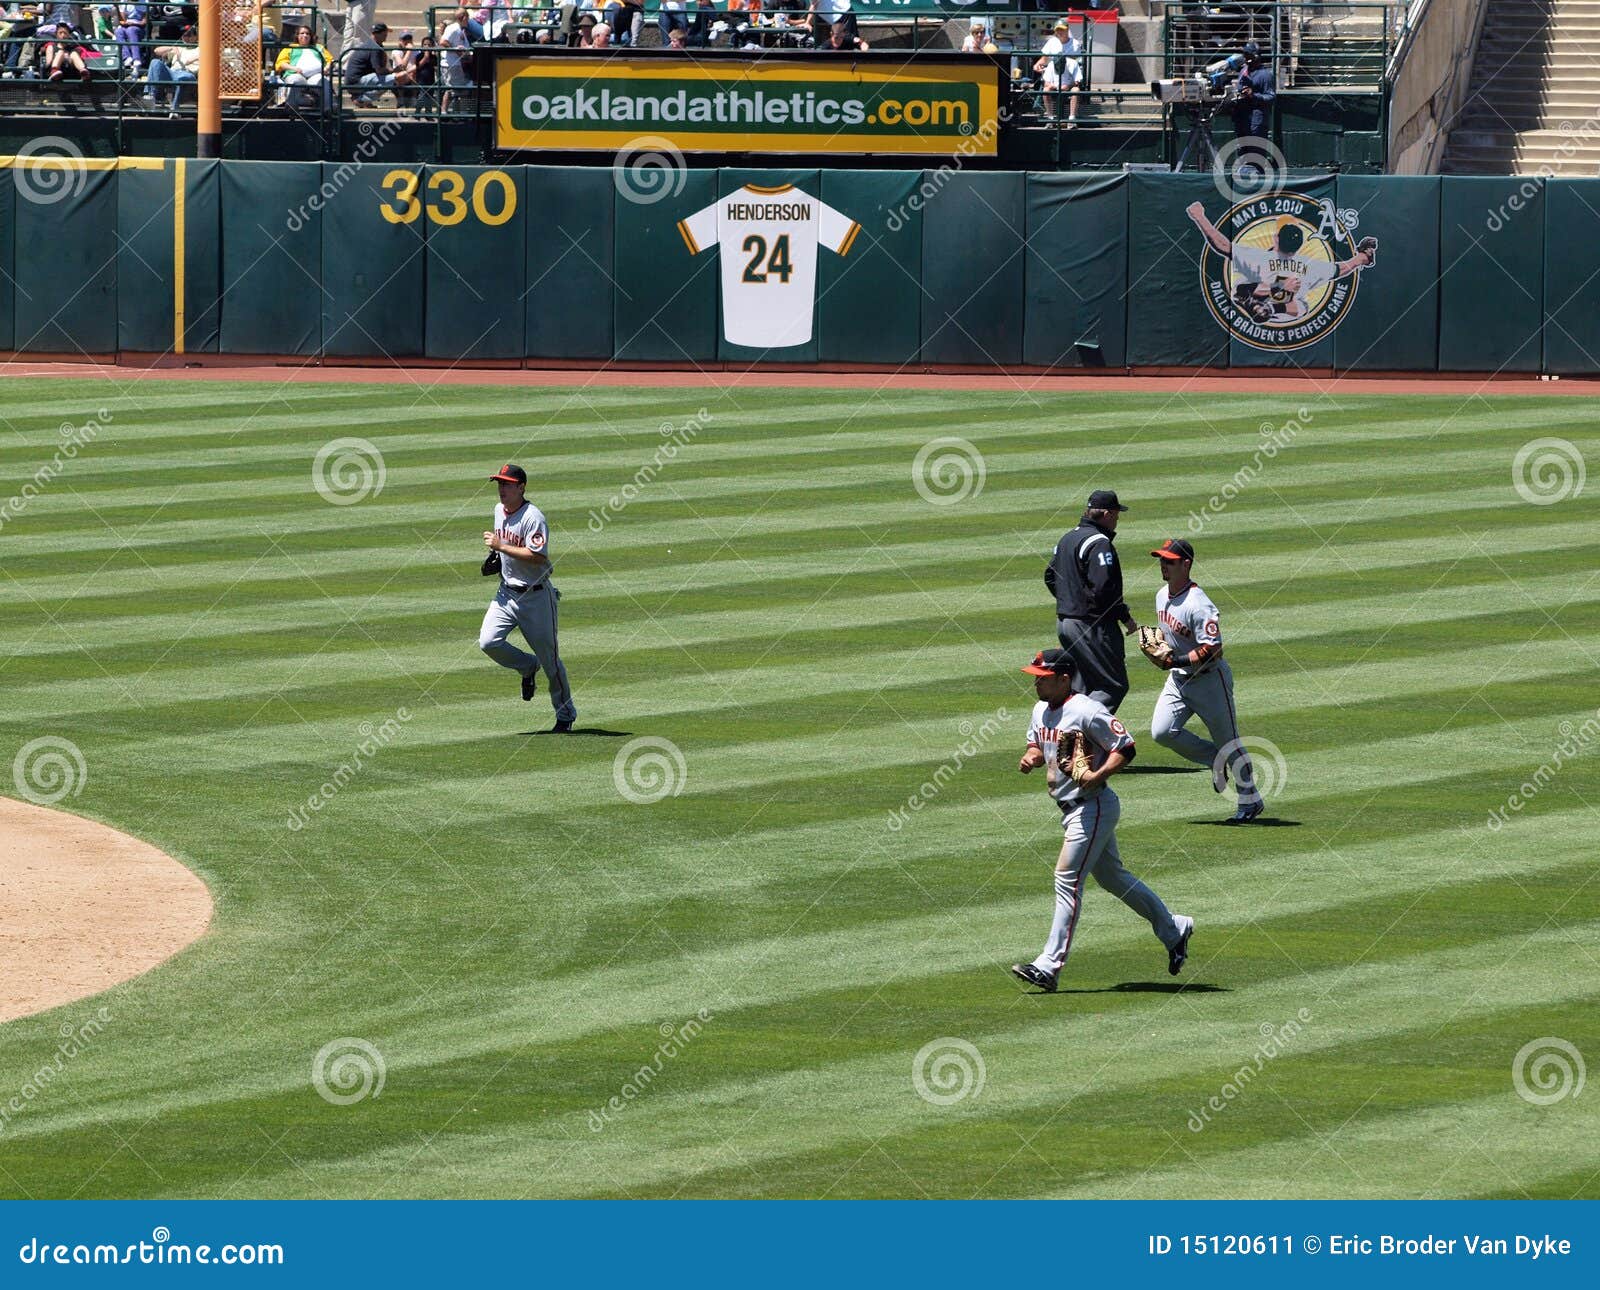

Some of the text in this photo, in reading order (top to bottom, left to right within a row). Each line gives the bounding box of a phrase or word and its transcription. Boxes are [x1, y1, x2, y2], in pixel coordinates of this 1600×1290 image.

[522, 88, 968, 126] oaklandathletics.com
[380, 169, 517, 226] 330
[727, 203, 811, 221] HENDERSON
[1231, 199, 1304, 228] MAY 9, 2010
[741, 233, 794, 284] 24
[1269, 258, 1308, 276] BRADEN
[1210, 280, 1349, 343] DALLAS BRADEN'S PERFECT GAME
[1097, 551, 1113, 566] 12
